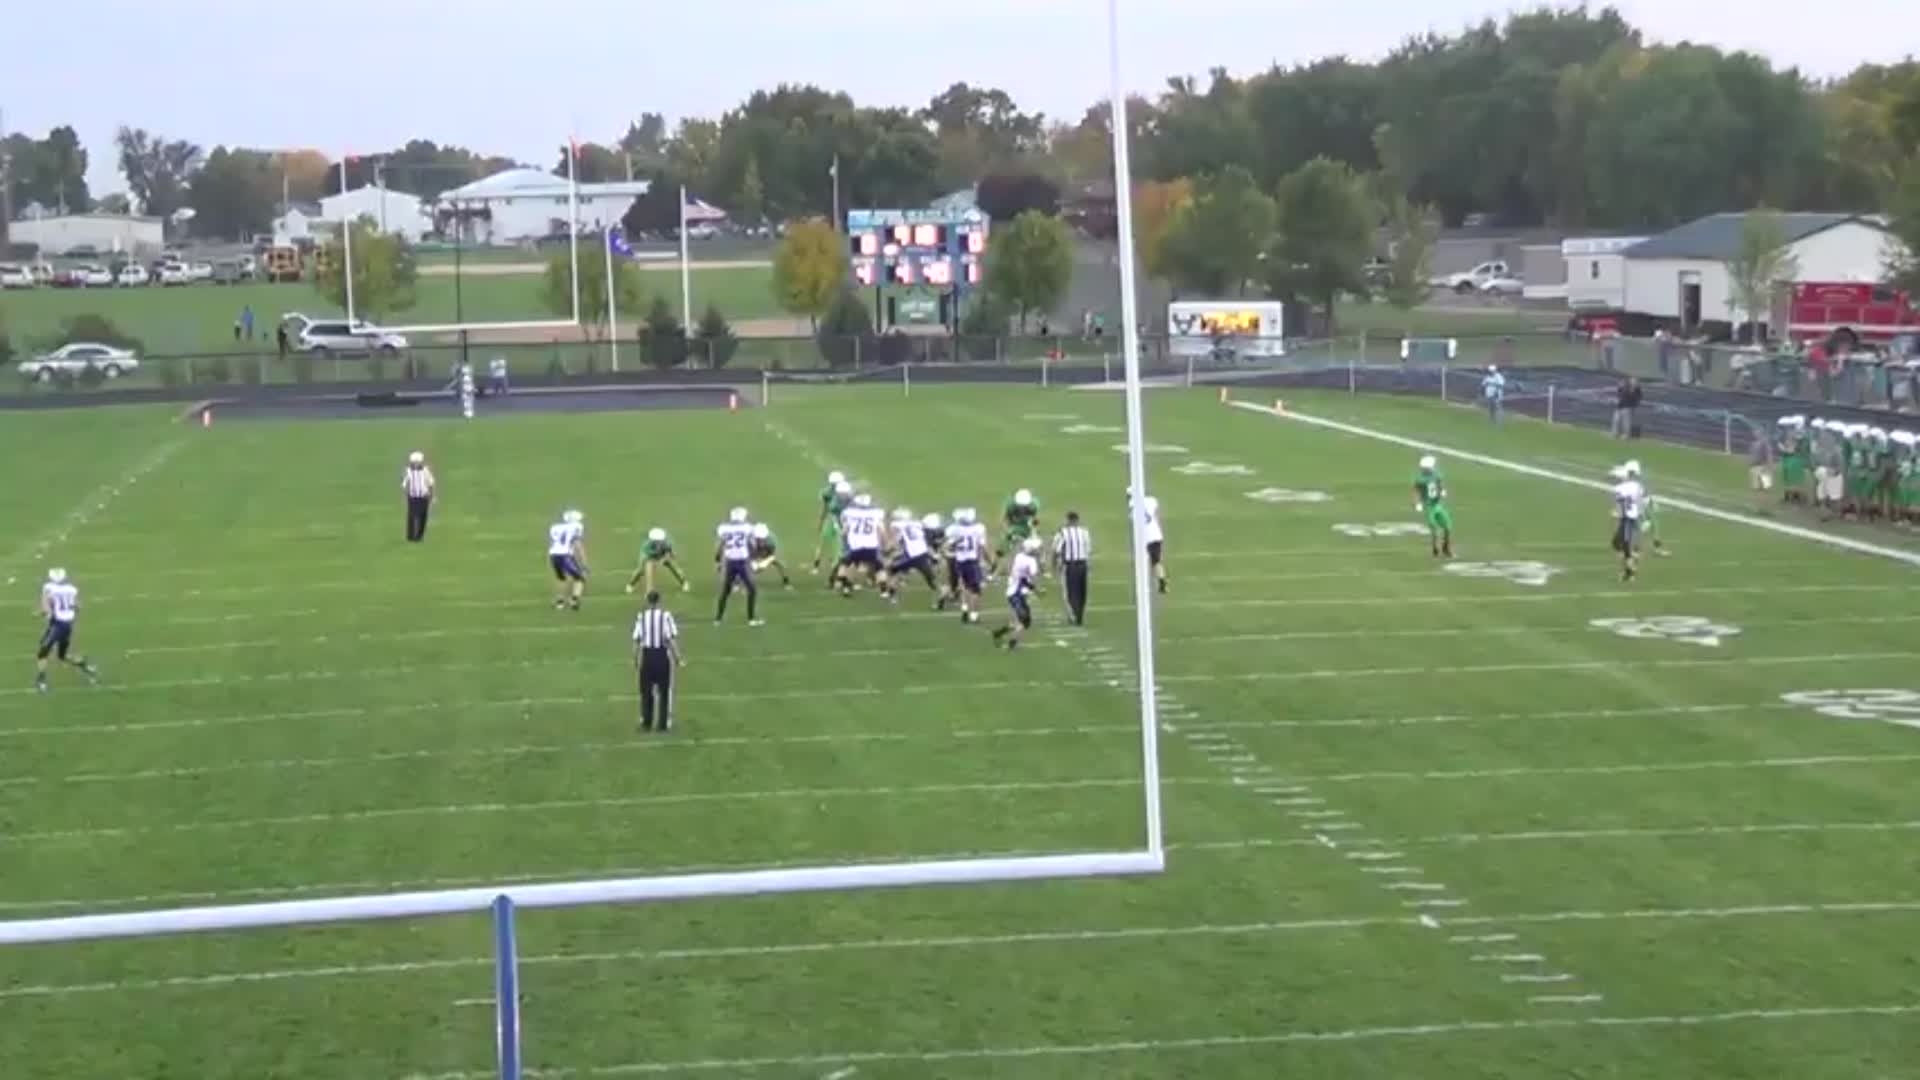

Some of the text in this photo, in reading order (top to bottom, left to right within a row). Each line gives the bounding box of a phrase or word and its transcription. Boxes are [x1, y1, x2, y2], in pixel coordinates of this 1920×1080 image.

[851, 517, 873, 534] 76
[725, 532, 745, 548] 22
[955, 536, 974, 550] 21
